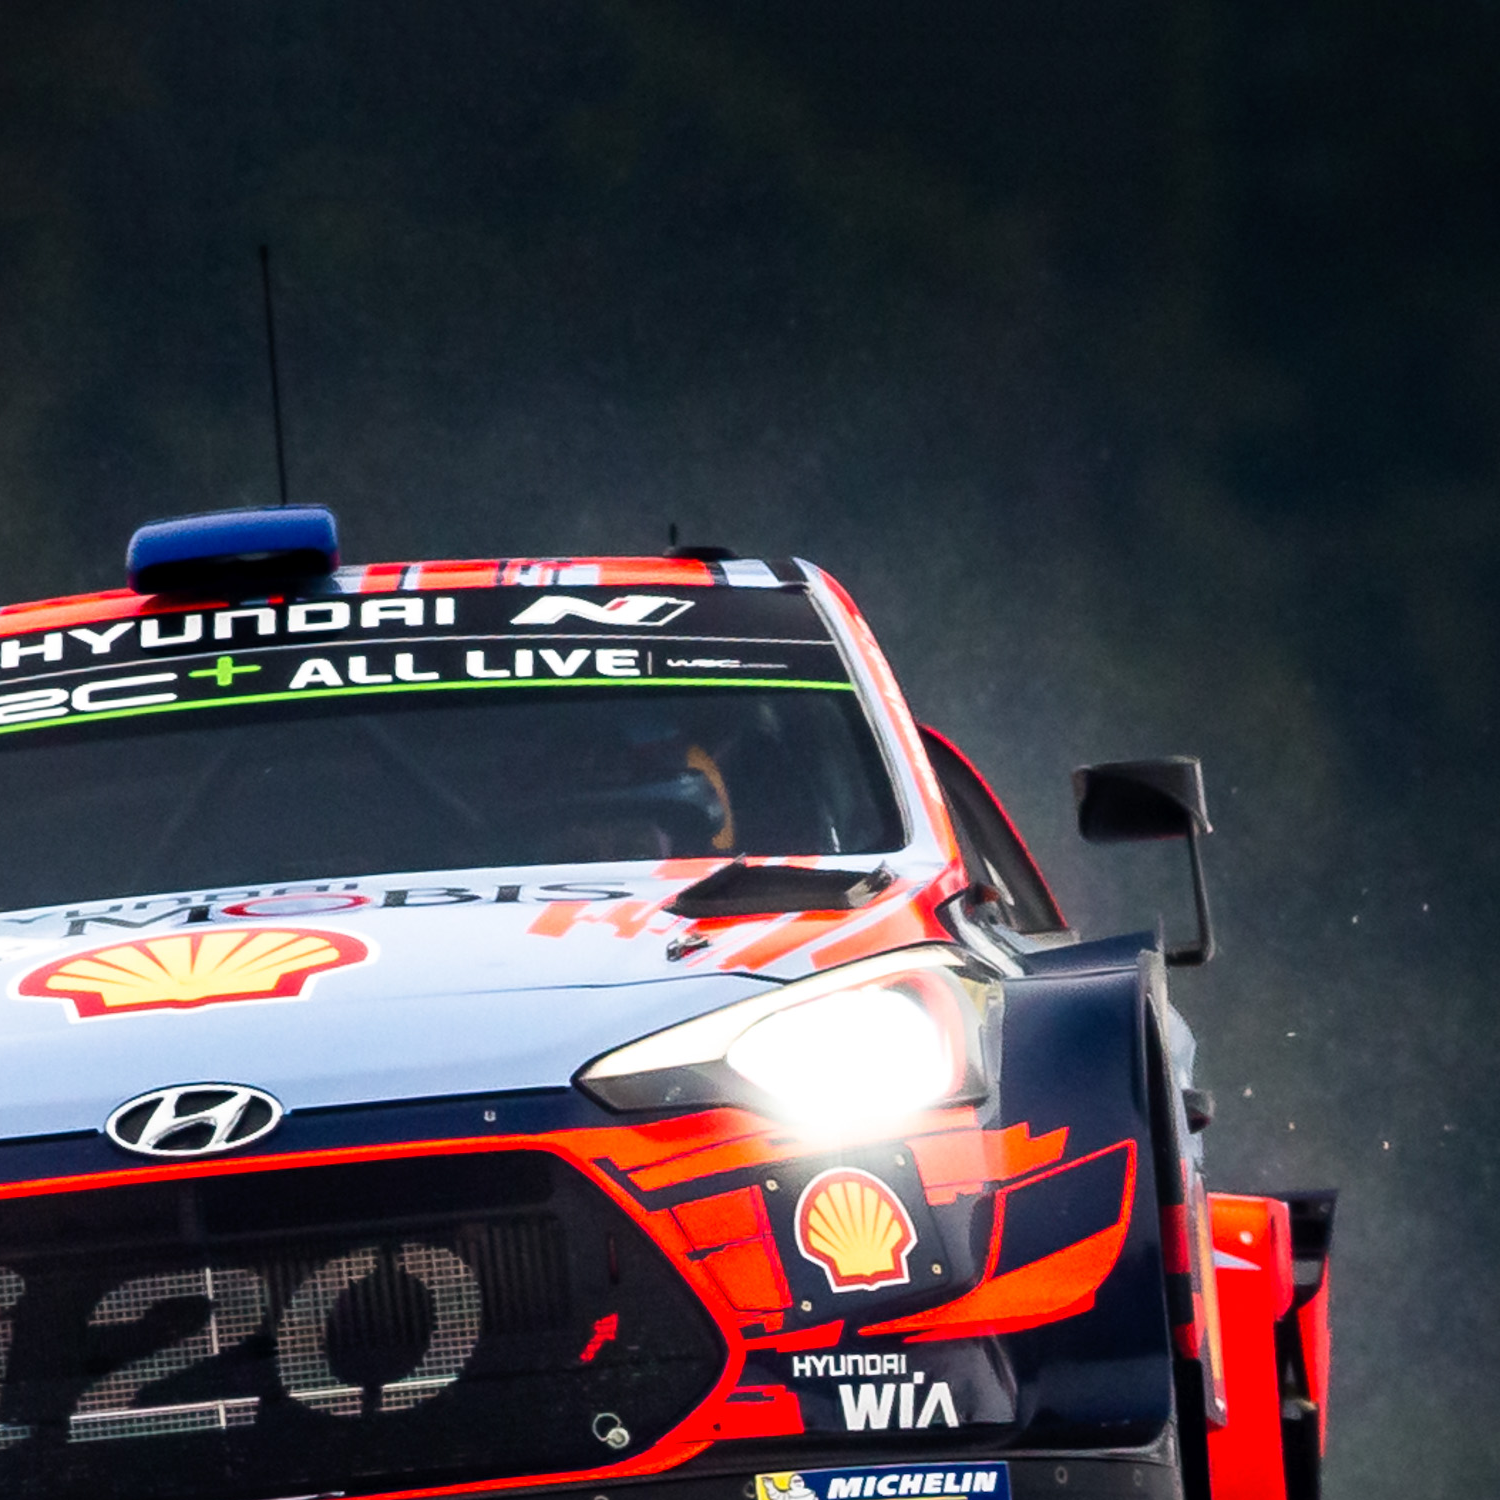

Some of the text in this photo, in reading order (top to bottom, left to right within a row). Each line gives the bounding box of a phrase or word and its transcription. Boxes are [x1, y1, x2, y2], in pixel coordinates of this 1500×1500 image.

[0, 597, 455, 668] HYUNDAI
[288, 650, 440, 690] ALL
[465, 648, 642, 679] LIVE
[62, 881, 634, 937] MOBIS
[792, 1353, 908, 1378] HYUNDAI
[838, 1370, 960, 1432] WIA
[826, 1470, 998, 1500] MICHELIN
